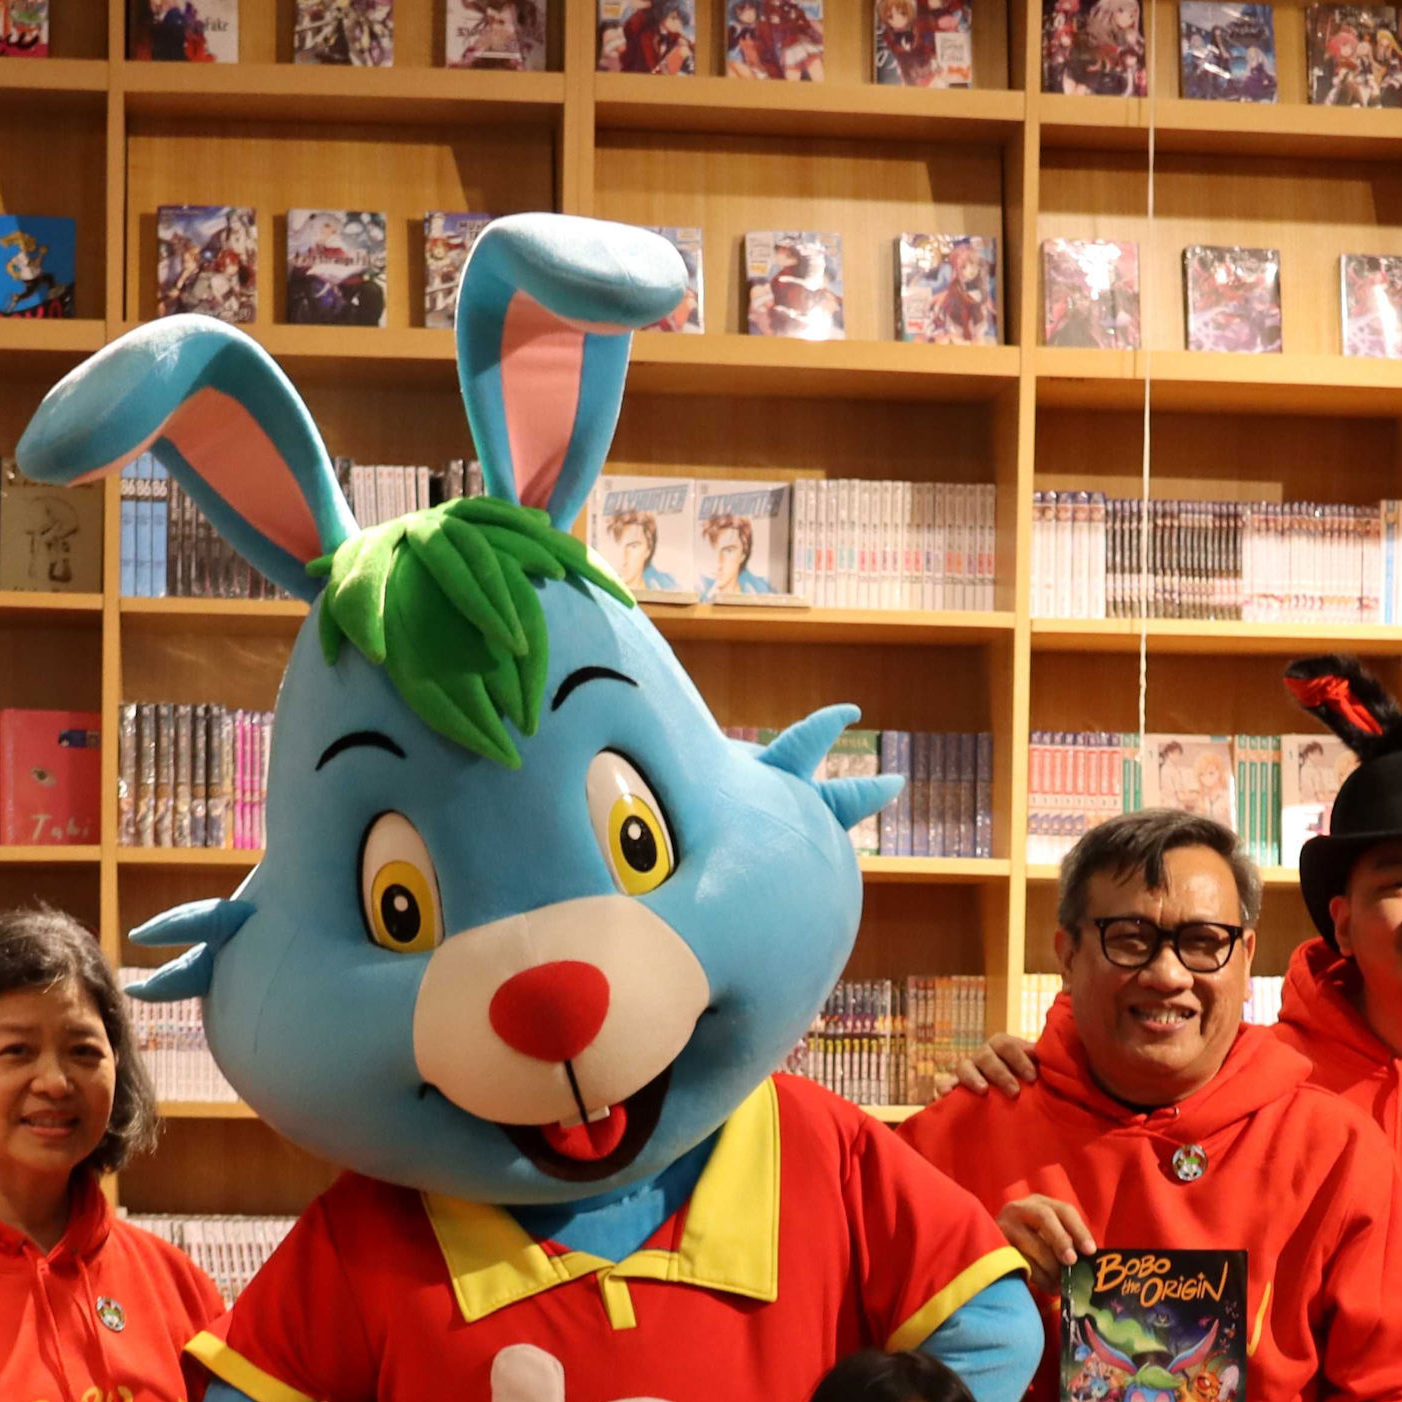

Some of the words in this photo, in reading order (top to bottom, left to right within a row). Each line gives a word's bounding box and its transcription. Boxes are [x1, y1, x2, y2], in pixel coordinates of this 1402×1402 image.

[136, 479, 152, 497] 86
[152, 480, 168, 498] 86
[1121, 1279, 1141, 1297] the
